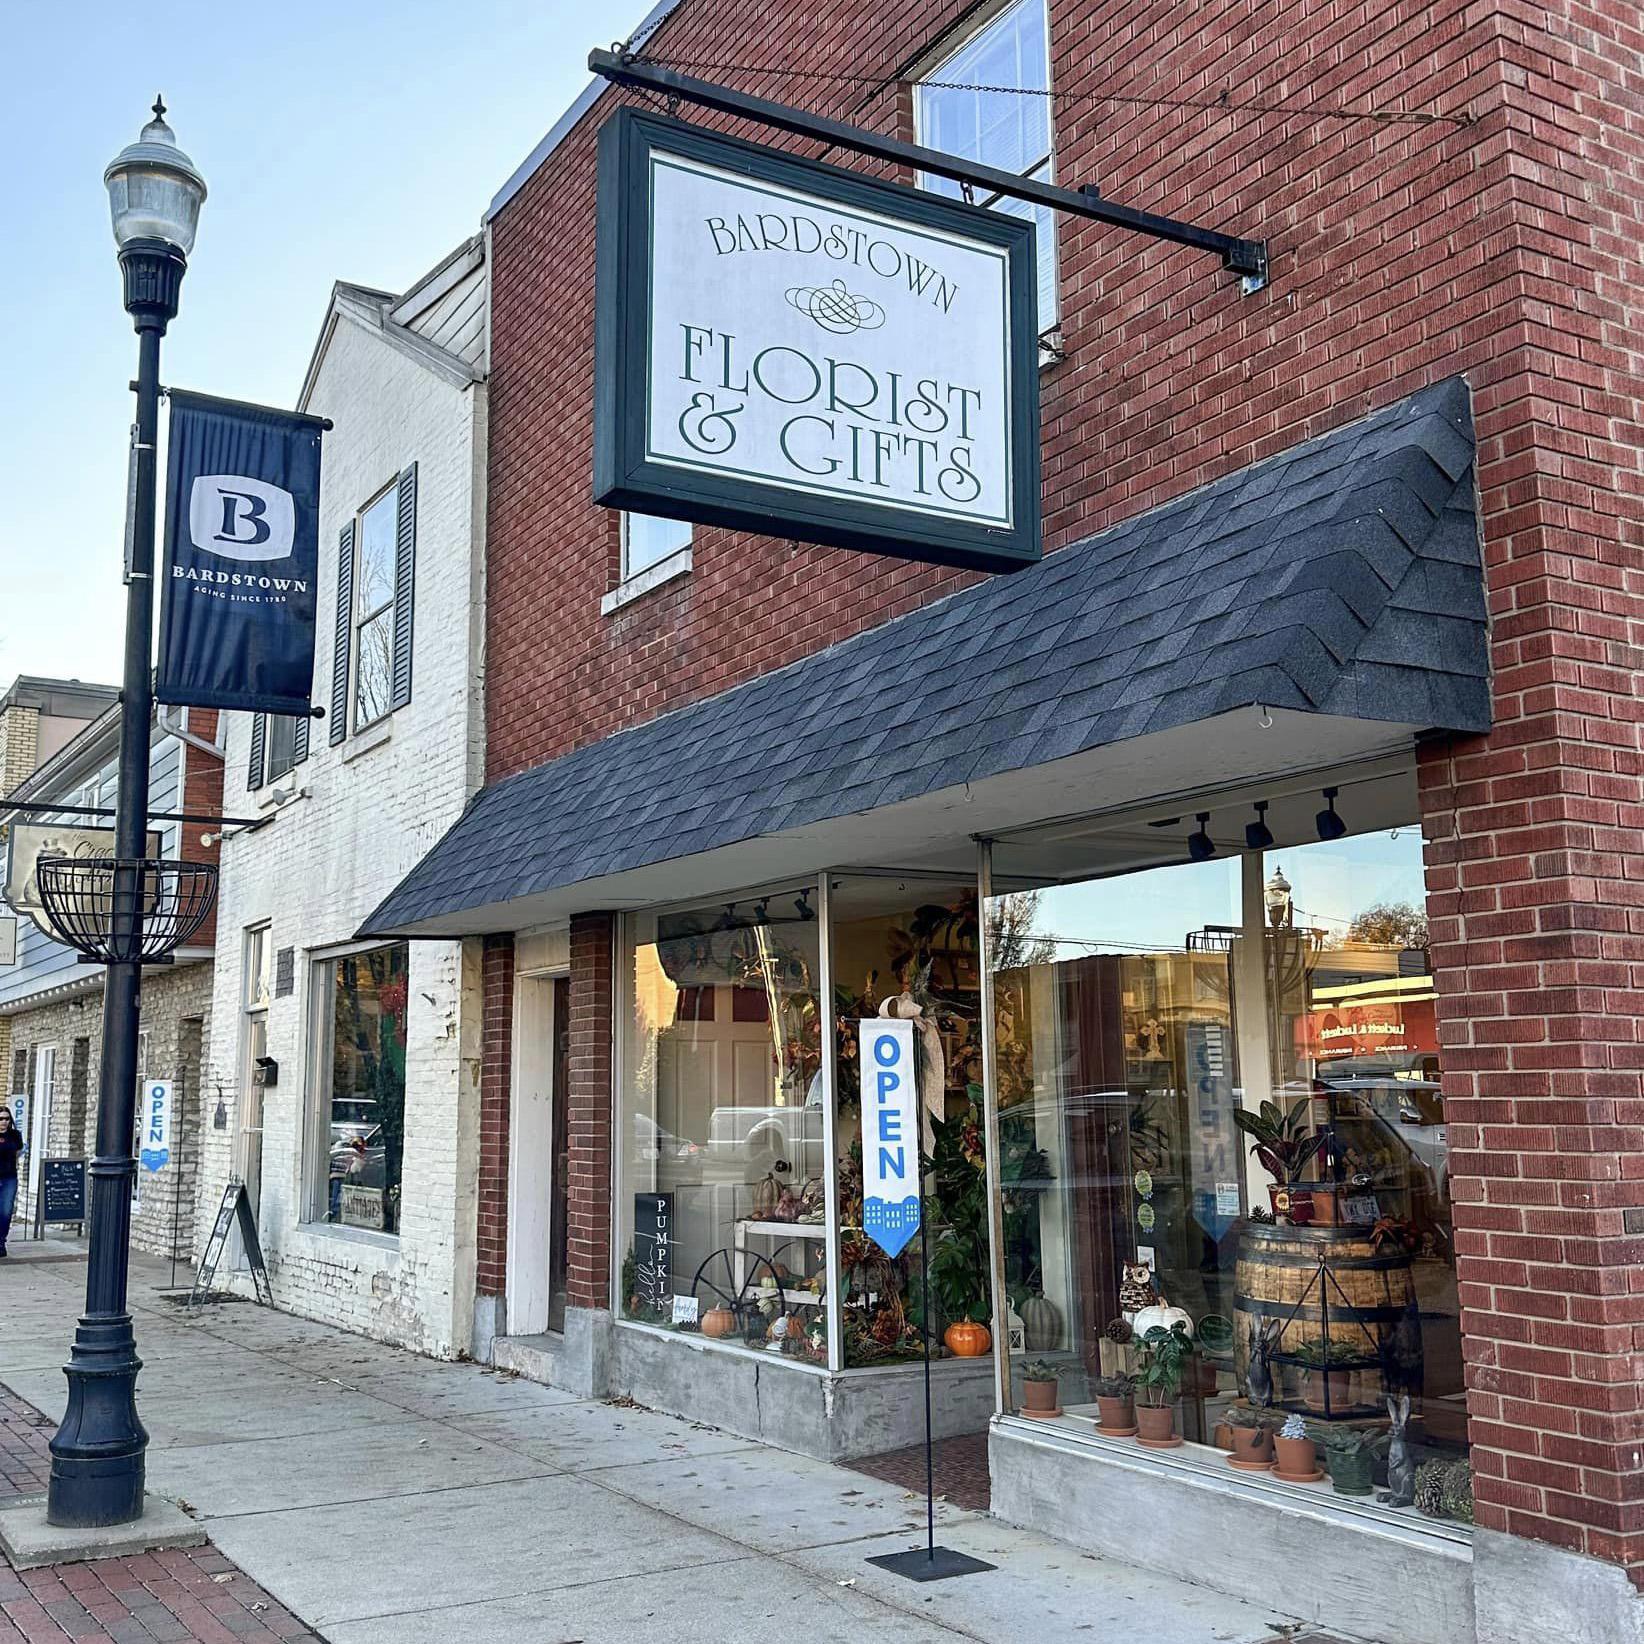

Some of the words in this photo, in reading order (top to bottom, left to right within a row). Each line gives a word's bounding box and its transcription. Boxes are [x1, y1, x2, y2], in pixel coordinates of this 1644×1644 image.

[704, 214, 960, 314] BARDSTOWN
[679, 323, 981, 441] FLORIST
[678, 392, 744, 455] &
[780, 415, 982, 503] GIFTS
[172, 565, 307, 593] BARDSTOWN
[193, 585, 226, 599] AGING
[230, 594, 261, 603] SINCE
[14, 1099, 25, 1131] OPE
[149, 1085, 166, 1143] OPEN
[873, 1034, 905, 1180] OPEN
